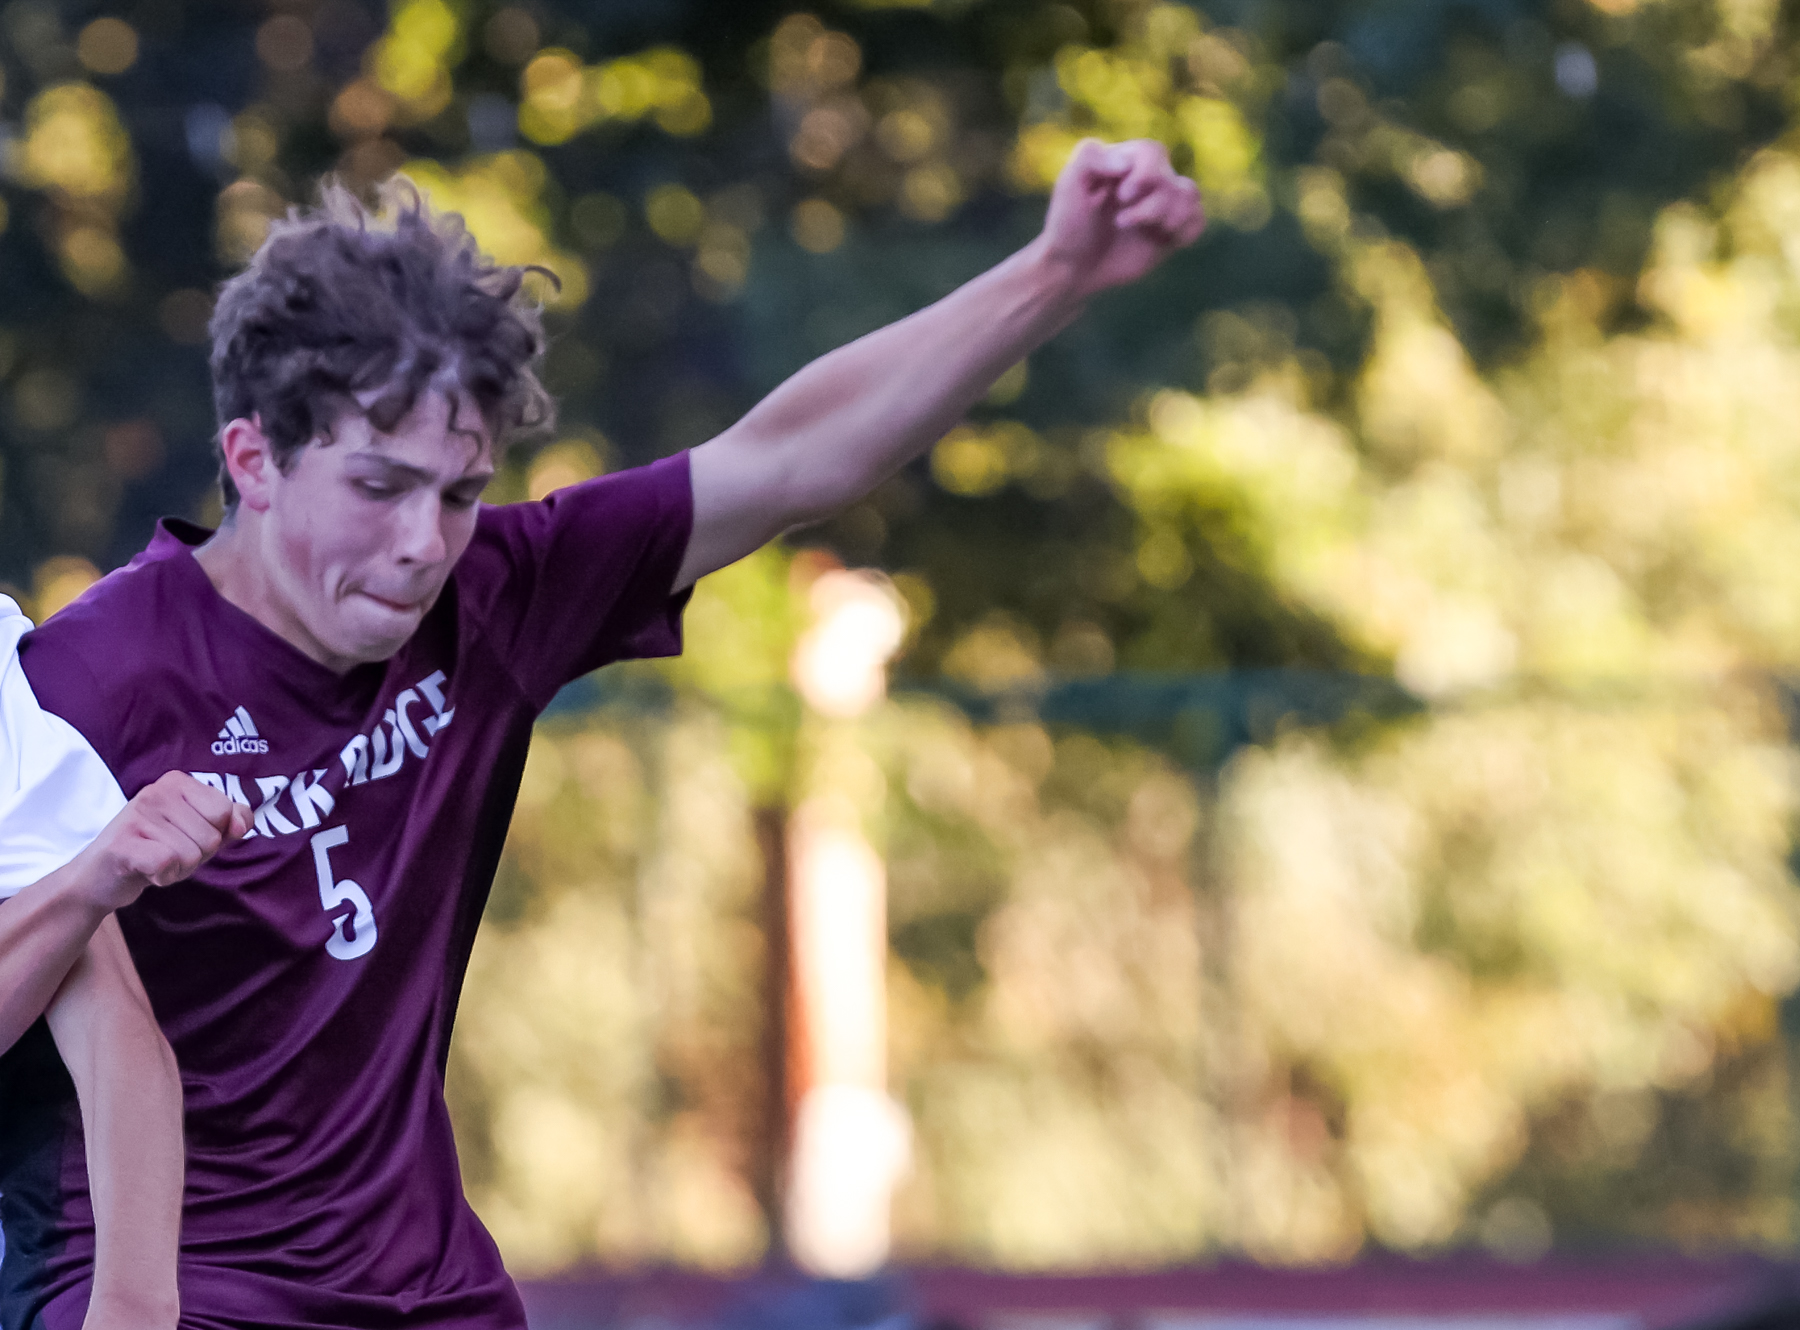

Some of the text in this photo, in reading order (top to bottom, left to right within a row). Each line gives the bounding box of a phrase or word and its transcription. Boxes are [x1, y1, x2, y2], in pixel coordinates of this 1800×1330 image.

[211, 736, 269, 755] adidas
[339, 669, 456, 788] RDGE
[310, 824, 378, 960] 5
